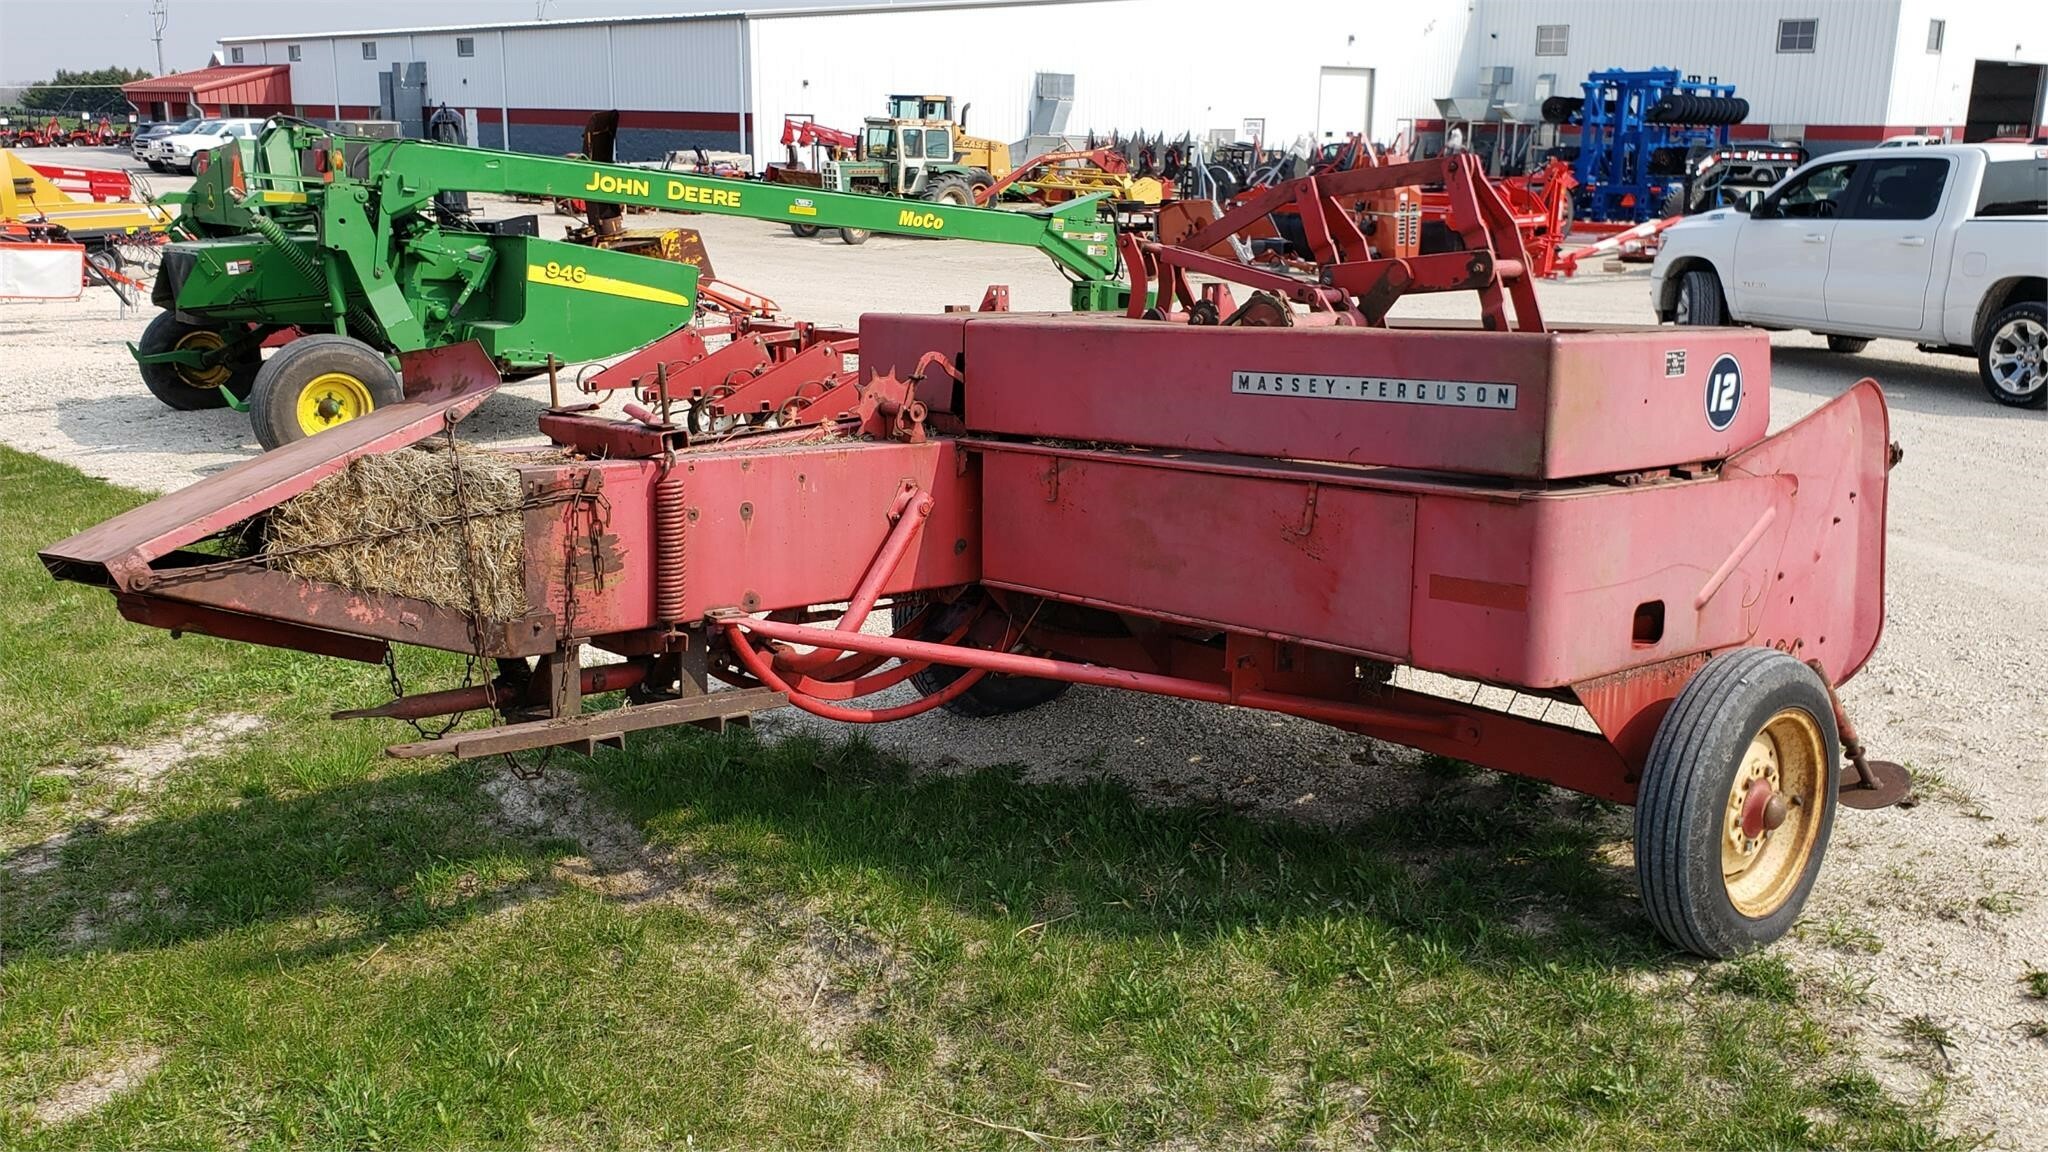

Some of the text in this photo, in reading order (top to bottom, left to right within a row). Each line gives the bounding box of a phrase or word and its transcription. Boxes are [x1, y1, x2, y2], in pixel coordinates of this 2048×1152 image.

[962, 139, 989, 149] CASE
[1746, 150, 1759, 161] PJ
[586, 172, 741, 208] JOHN DEERE
[898, 210, 944, 230] MoCo
[545, 261, 587, 283] 946
[1709, 372, 1737, 412] 12
